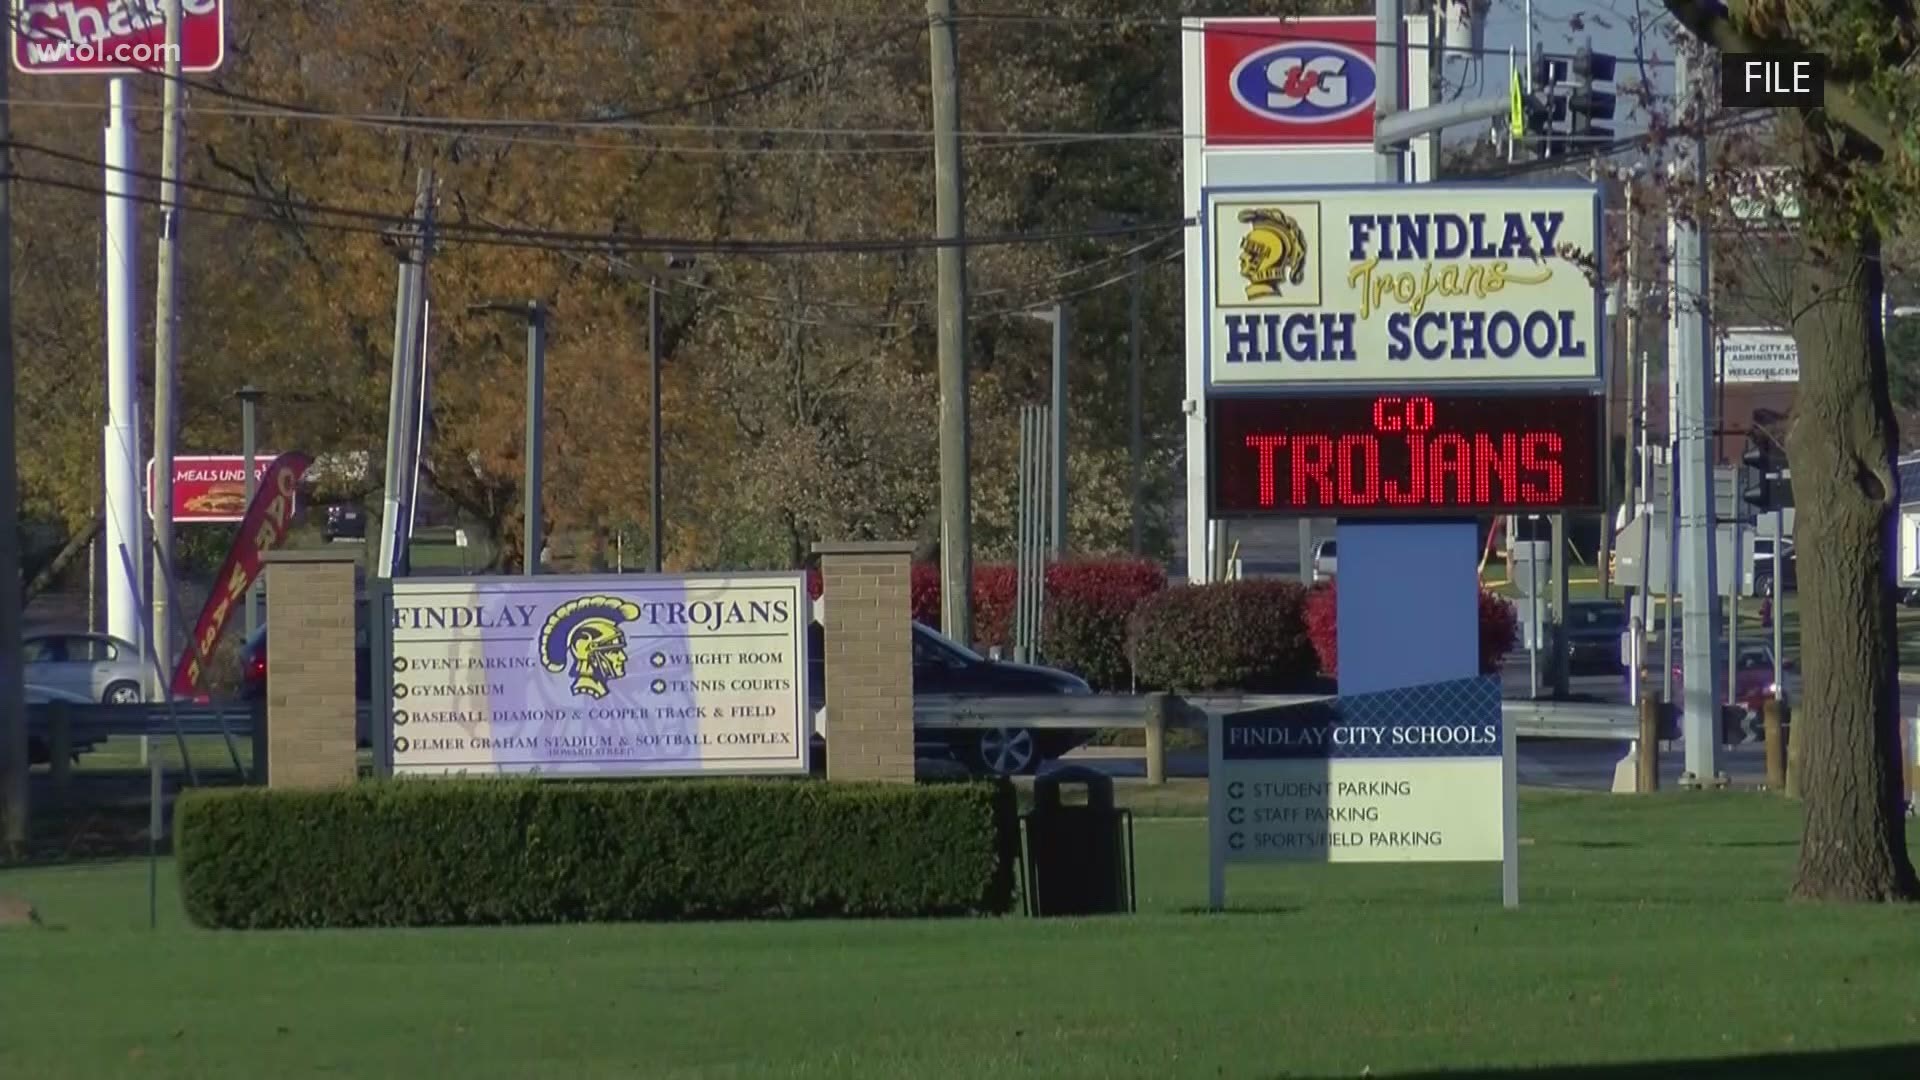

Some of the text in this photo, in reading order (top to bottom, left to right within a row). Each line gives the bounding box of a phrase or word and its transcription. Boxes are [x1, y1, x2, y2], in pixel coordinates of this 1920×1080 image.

[1265, 56, 1349, 108] S&G
[1348, 211, 1565, 262] FINDLAY
[1347, 256, 1554, 320] Trojans
[1225, 310, 1587, 363] HIGH SCHOOL
[1732, 352, 1798, 362] ADMINISTRAT
[1760, 343, 1782, 353] CITY
[1373, 396, 1435, 431] GO
[176, 469, 262, 482] MEALS UNDR
[1246, 432, 1564, 505] TROJANS
[393, 604, 537, 631] FINDLAY
[643, 600, 789, 632] TROJANS
[411, 656, 536, 671] EVENT PARKING
[670, 652, 783, 666] WEIGHT ROOM
[411, 684, 505, 698] GYMNASIUM
[672, 678, 791, 692] TENNIS COURTS
[411, 711, 488, 724] BASEBALL
[493, 708, 566, 723] DIAMOND
[588, 706, 649, 721] COOPER
[656, 704, 707, 719] TRACK
[713, 705, 725, 718] &
[731, 703, 777, 718] FIELD
[412, 737, 464, 750] ELMER
[470, 734, 538, 750] GRAHAM
[544, 735, 613, 748] STADIUM
[635, 732, 712, 746] SOFTBALL
[717, 731, 790, 745] COMPLEX
[1229, 724, 1497, 745] FINDLAY CITY SCHOOLS
[1253, 781, 1411, 797] STUDENT PARKING
[1253, 806, 1379, 822] STAFF PARKING
[1253, 831, 1442, 848] SPORTS/FIELD PARKING
